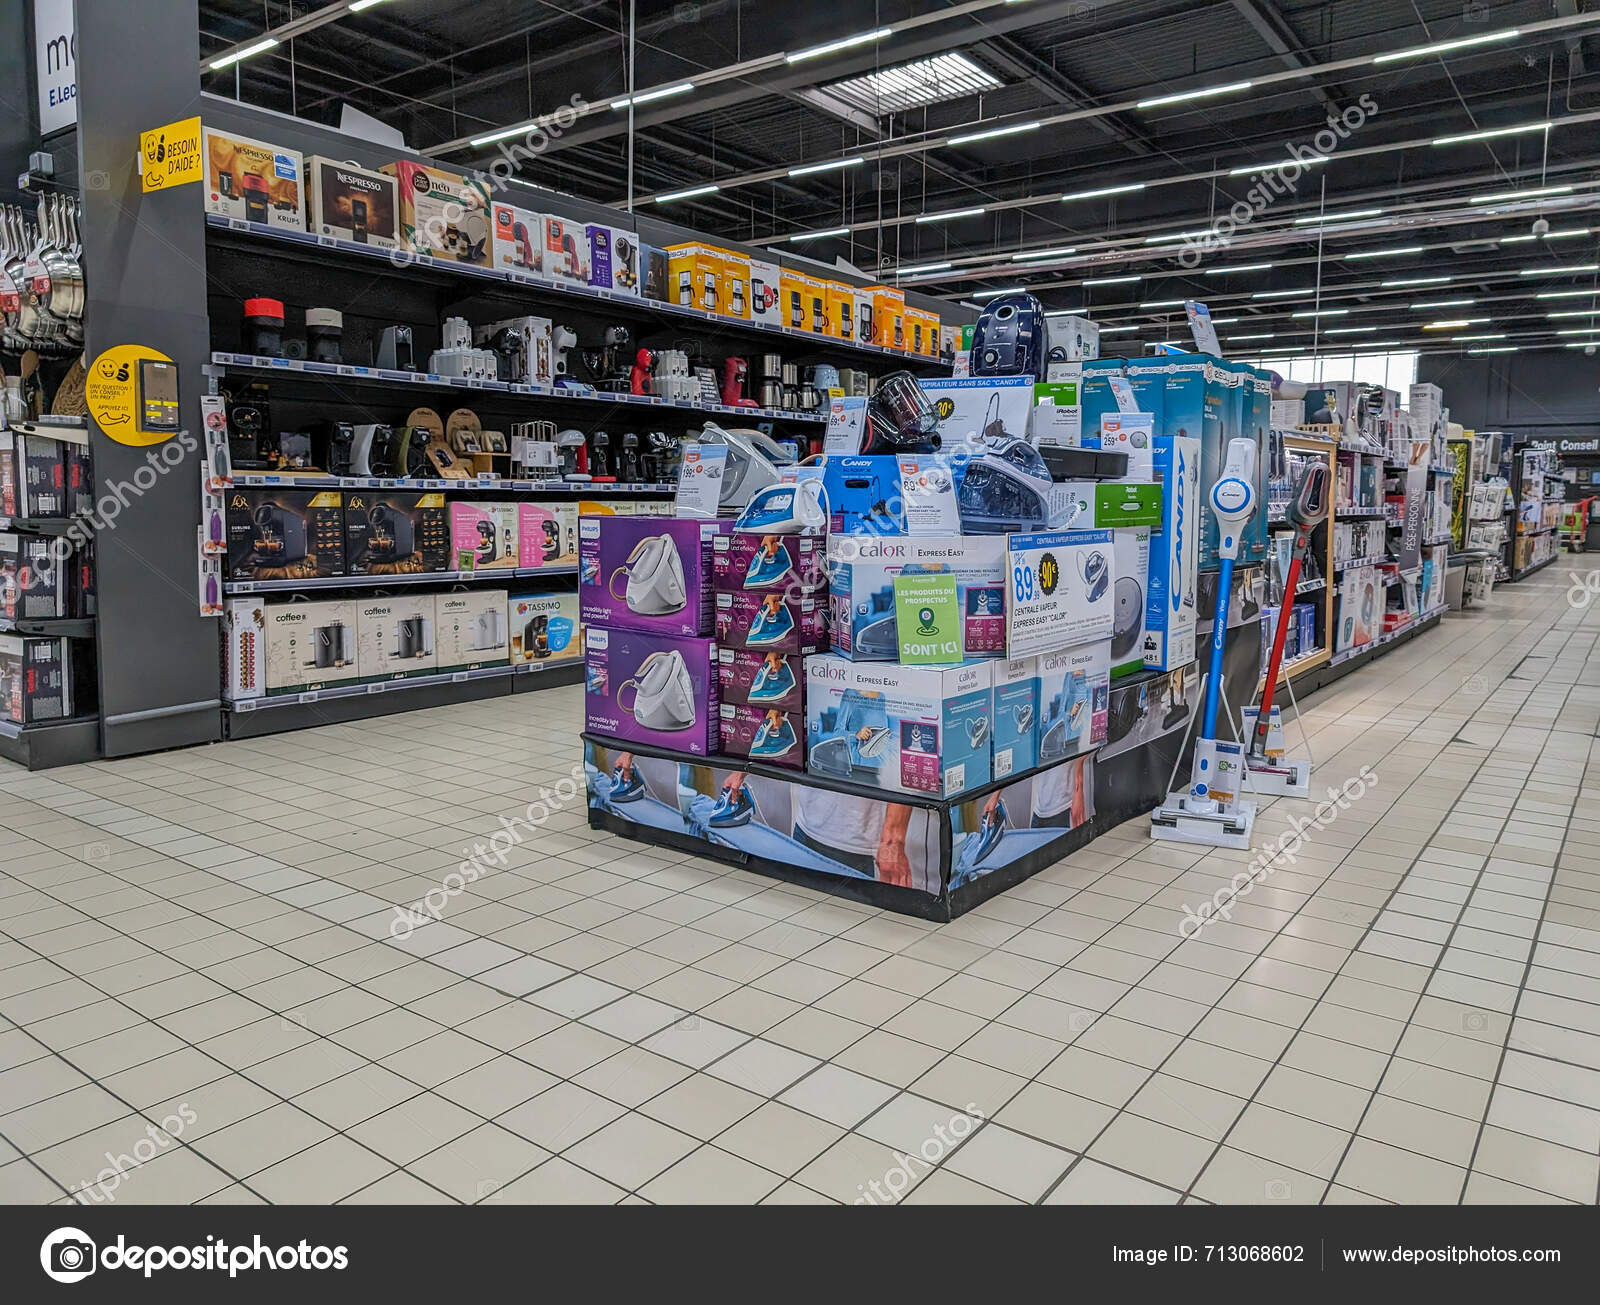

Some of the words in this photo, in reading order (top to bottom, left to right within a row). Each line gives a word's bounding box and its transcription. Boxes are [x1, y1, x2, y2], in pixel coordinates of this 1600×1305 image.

[167, 137, 198, 158] BESOIN
[233, 144, 274, 161] NESPRESSO
[168, 155, 193, 175] D'AIDE
[335, 171, 382, 191] NESPRESSO
[277, 215, 300, 225] KRUPS
[958, 379, 977, 387] SANS
[1531, 440, 1557, 450] Point
[1560, 439, 1599, 451] Conseil
[917, 549, 947, 557] EXPRESS
[947, 549, 965, 557] EASY
[897, 588, 908, 596] LES
[909, 588, 942, 596] PRODUITS
[364, 606, 387, 616] coffee
[527, 601, 561, 612] TASSIMO
[583, 606, 602, 614] Incredibly
[603, 607, 612, 615] light
[1014, 605, 1039, 617] CENTRALE
[275, 613, 301, 623] coffee
[1013, 617, 1036, 630] EXPRESS
[1036, 615, 1048, 625] EASY
[588, 635, 607, 643] PHILIPS
[1214, 618, 1225, 650] CANDY
[903, 642, 937, 656] SONT
[941, 640, 958, 655] ICI
[735, 652, 751, 660] Einfach
[856, 674, 882, 685] EXPRESS
[883, 677, 899, 687] EASY
[588, 715, 609, 725] Incredibly
[610, 718, 619, 727] light
[745, 715, 761, 723] effektiv
[597, 723, 616, 732] powerful
